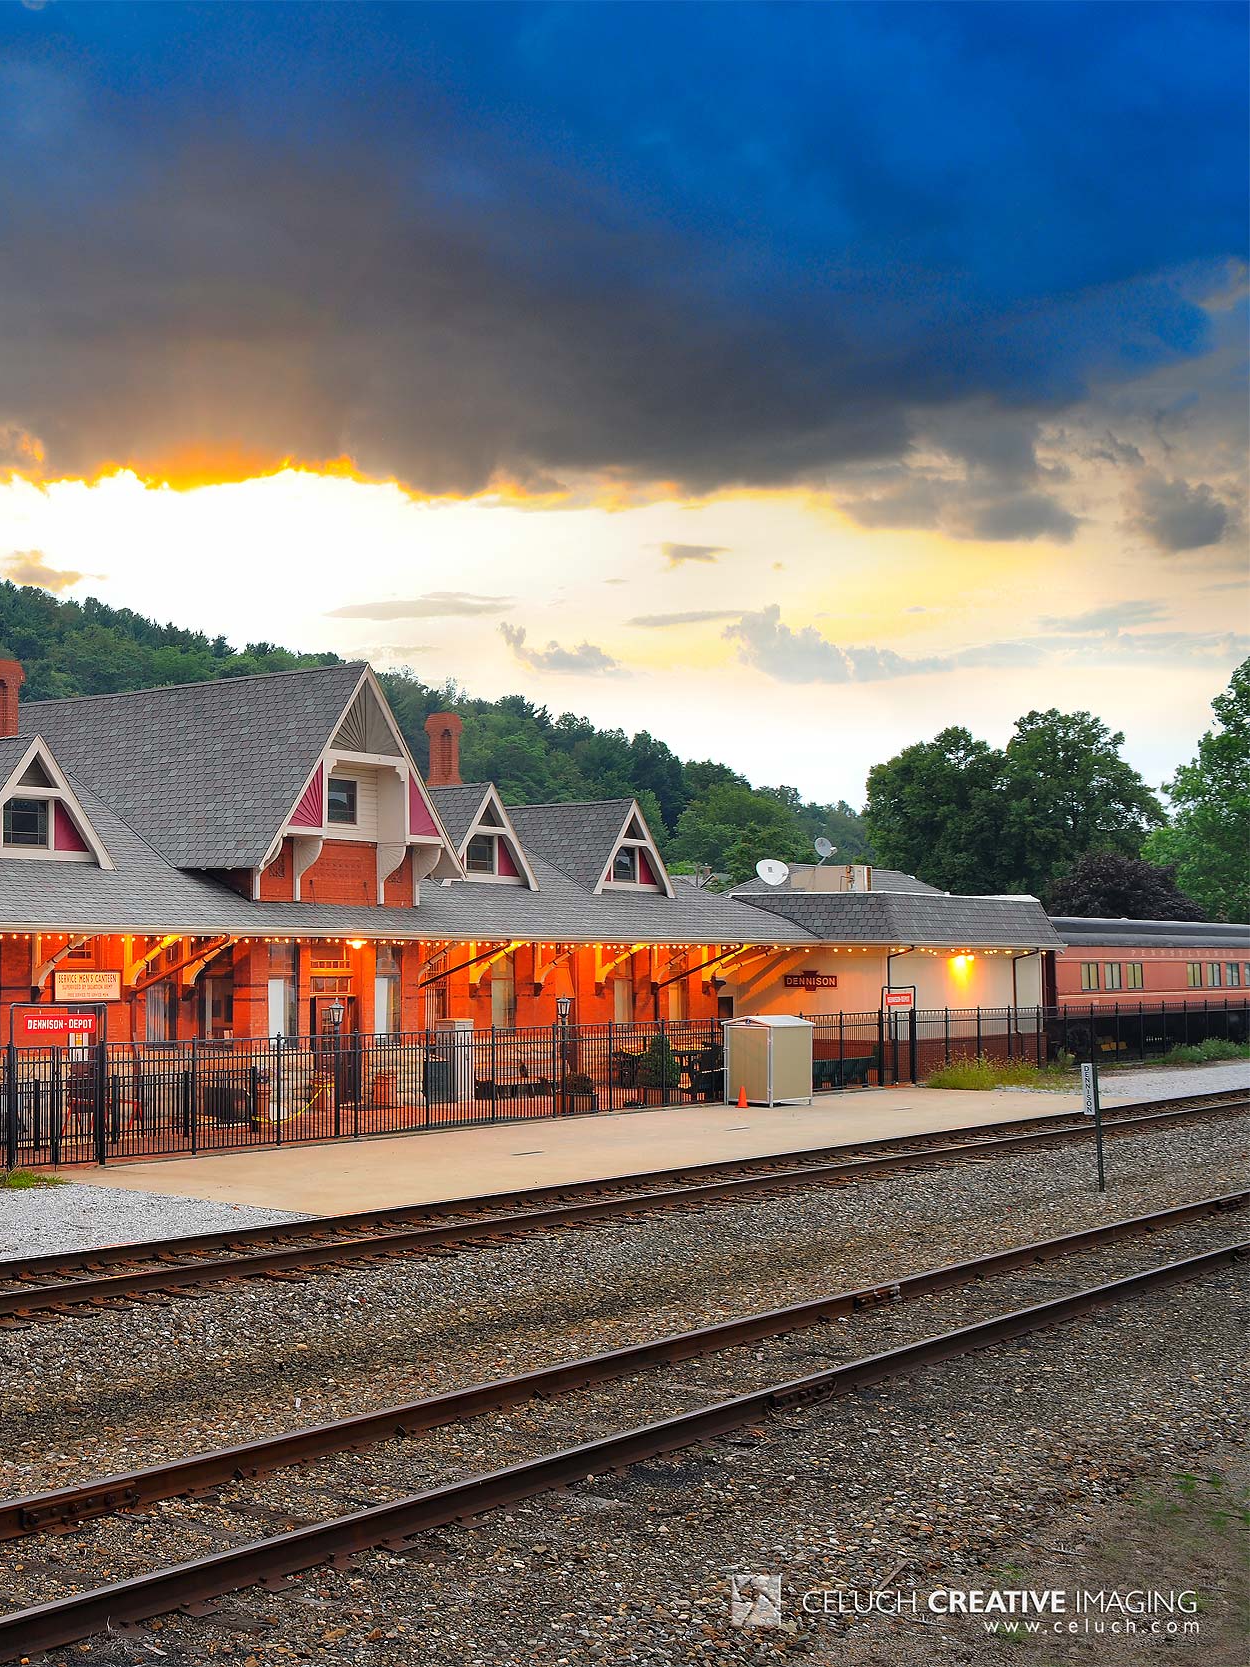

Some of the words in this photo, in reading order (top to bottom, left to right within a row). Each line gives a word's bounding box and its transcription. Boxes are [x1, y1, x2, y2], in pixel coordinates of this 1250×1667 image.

[1131, 949, 1234, 957] PENNSYLVANIA
[58, 974, 77, 983] SERVICE
[94, 974, 117, 983] CANTEEN
[786, 977, 836, 986] DENNISON
[1083, 1065, 1093, 1113] DENNISON
